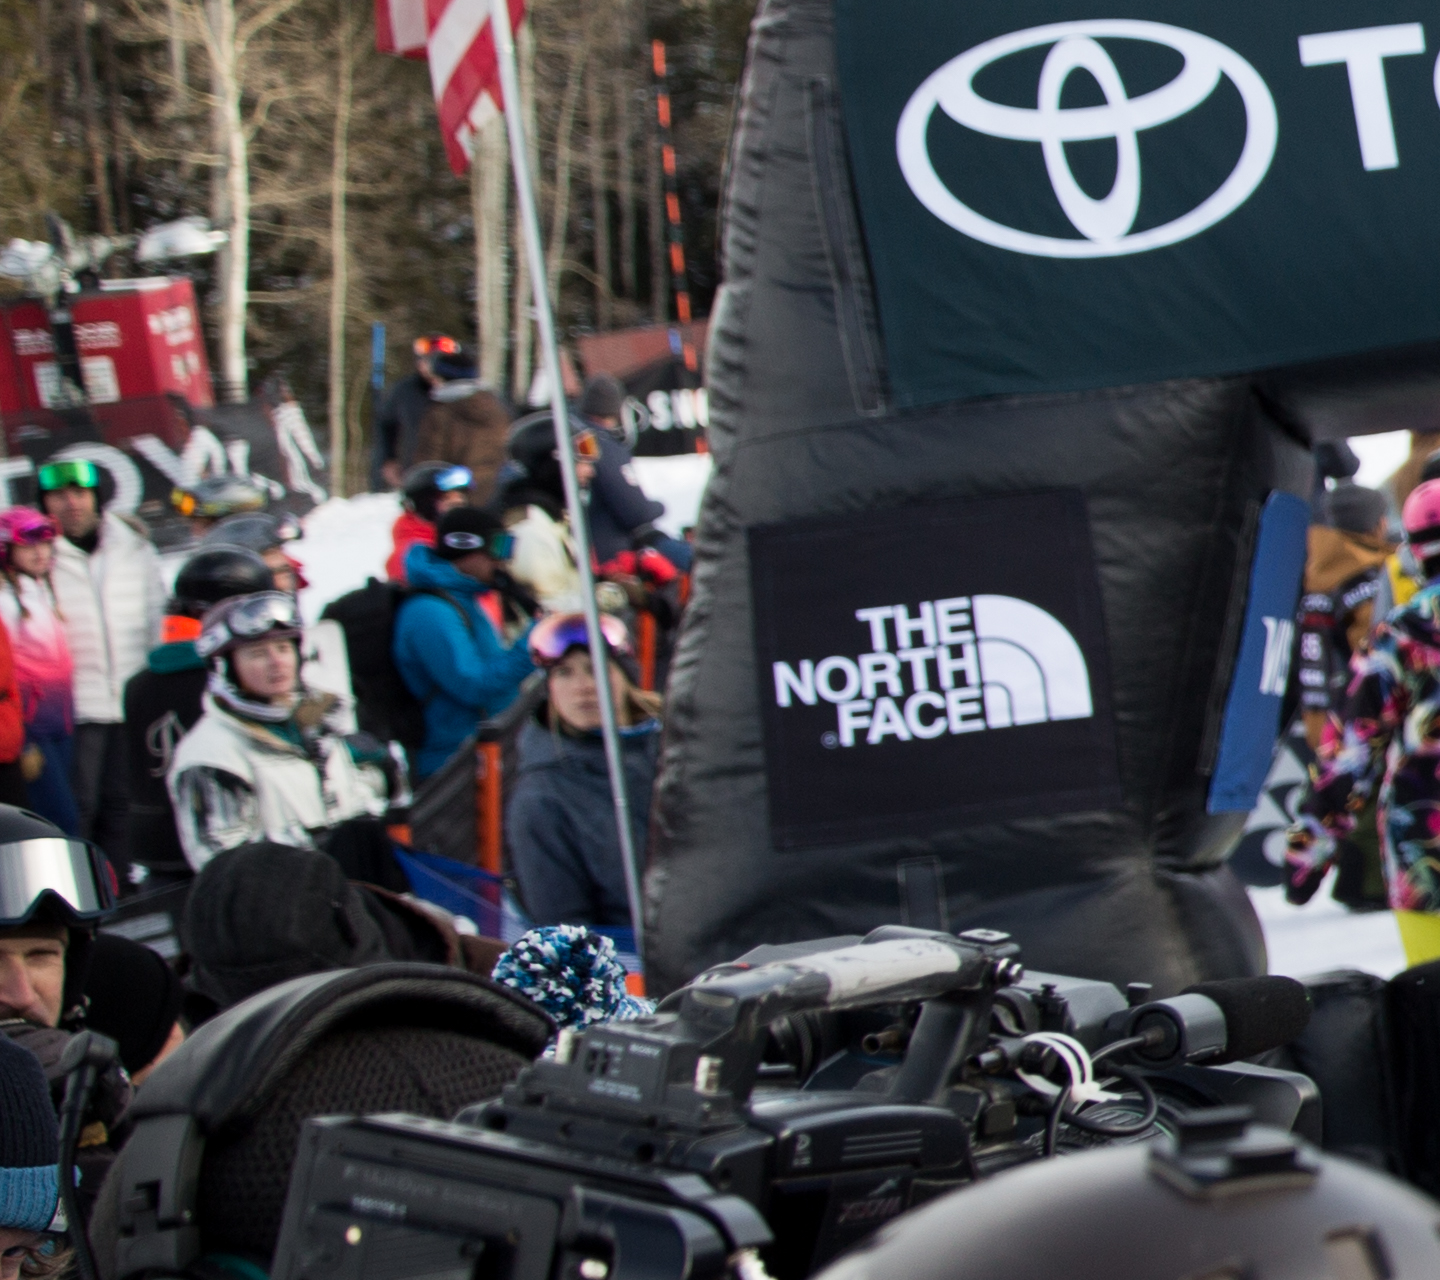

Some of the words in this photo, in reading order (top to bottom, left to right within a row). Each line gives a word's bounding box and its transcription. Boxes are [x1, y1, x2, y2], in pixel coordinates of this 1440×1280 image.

[855, 595, 973, 652] THE
[772, 643, 979, 708] NORTH
[836, 685, 988, 748] FACE
